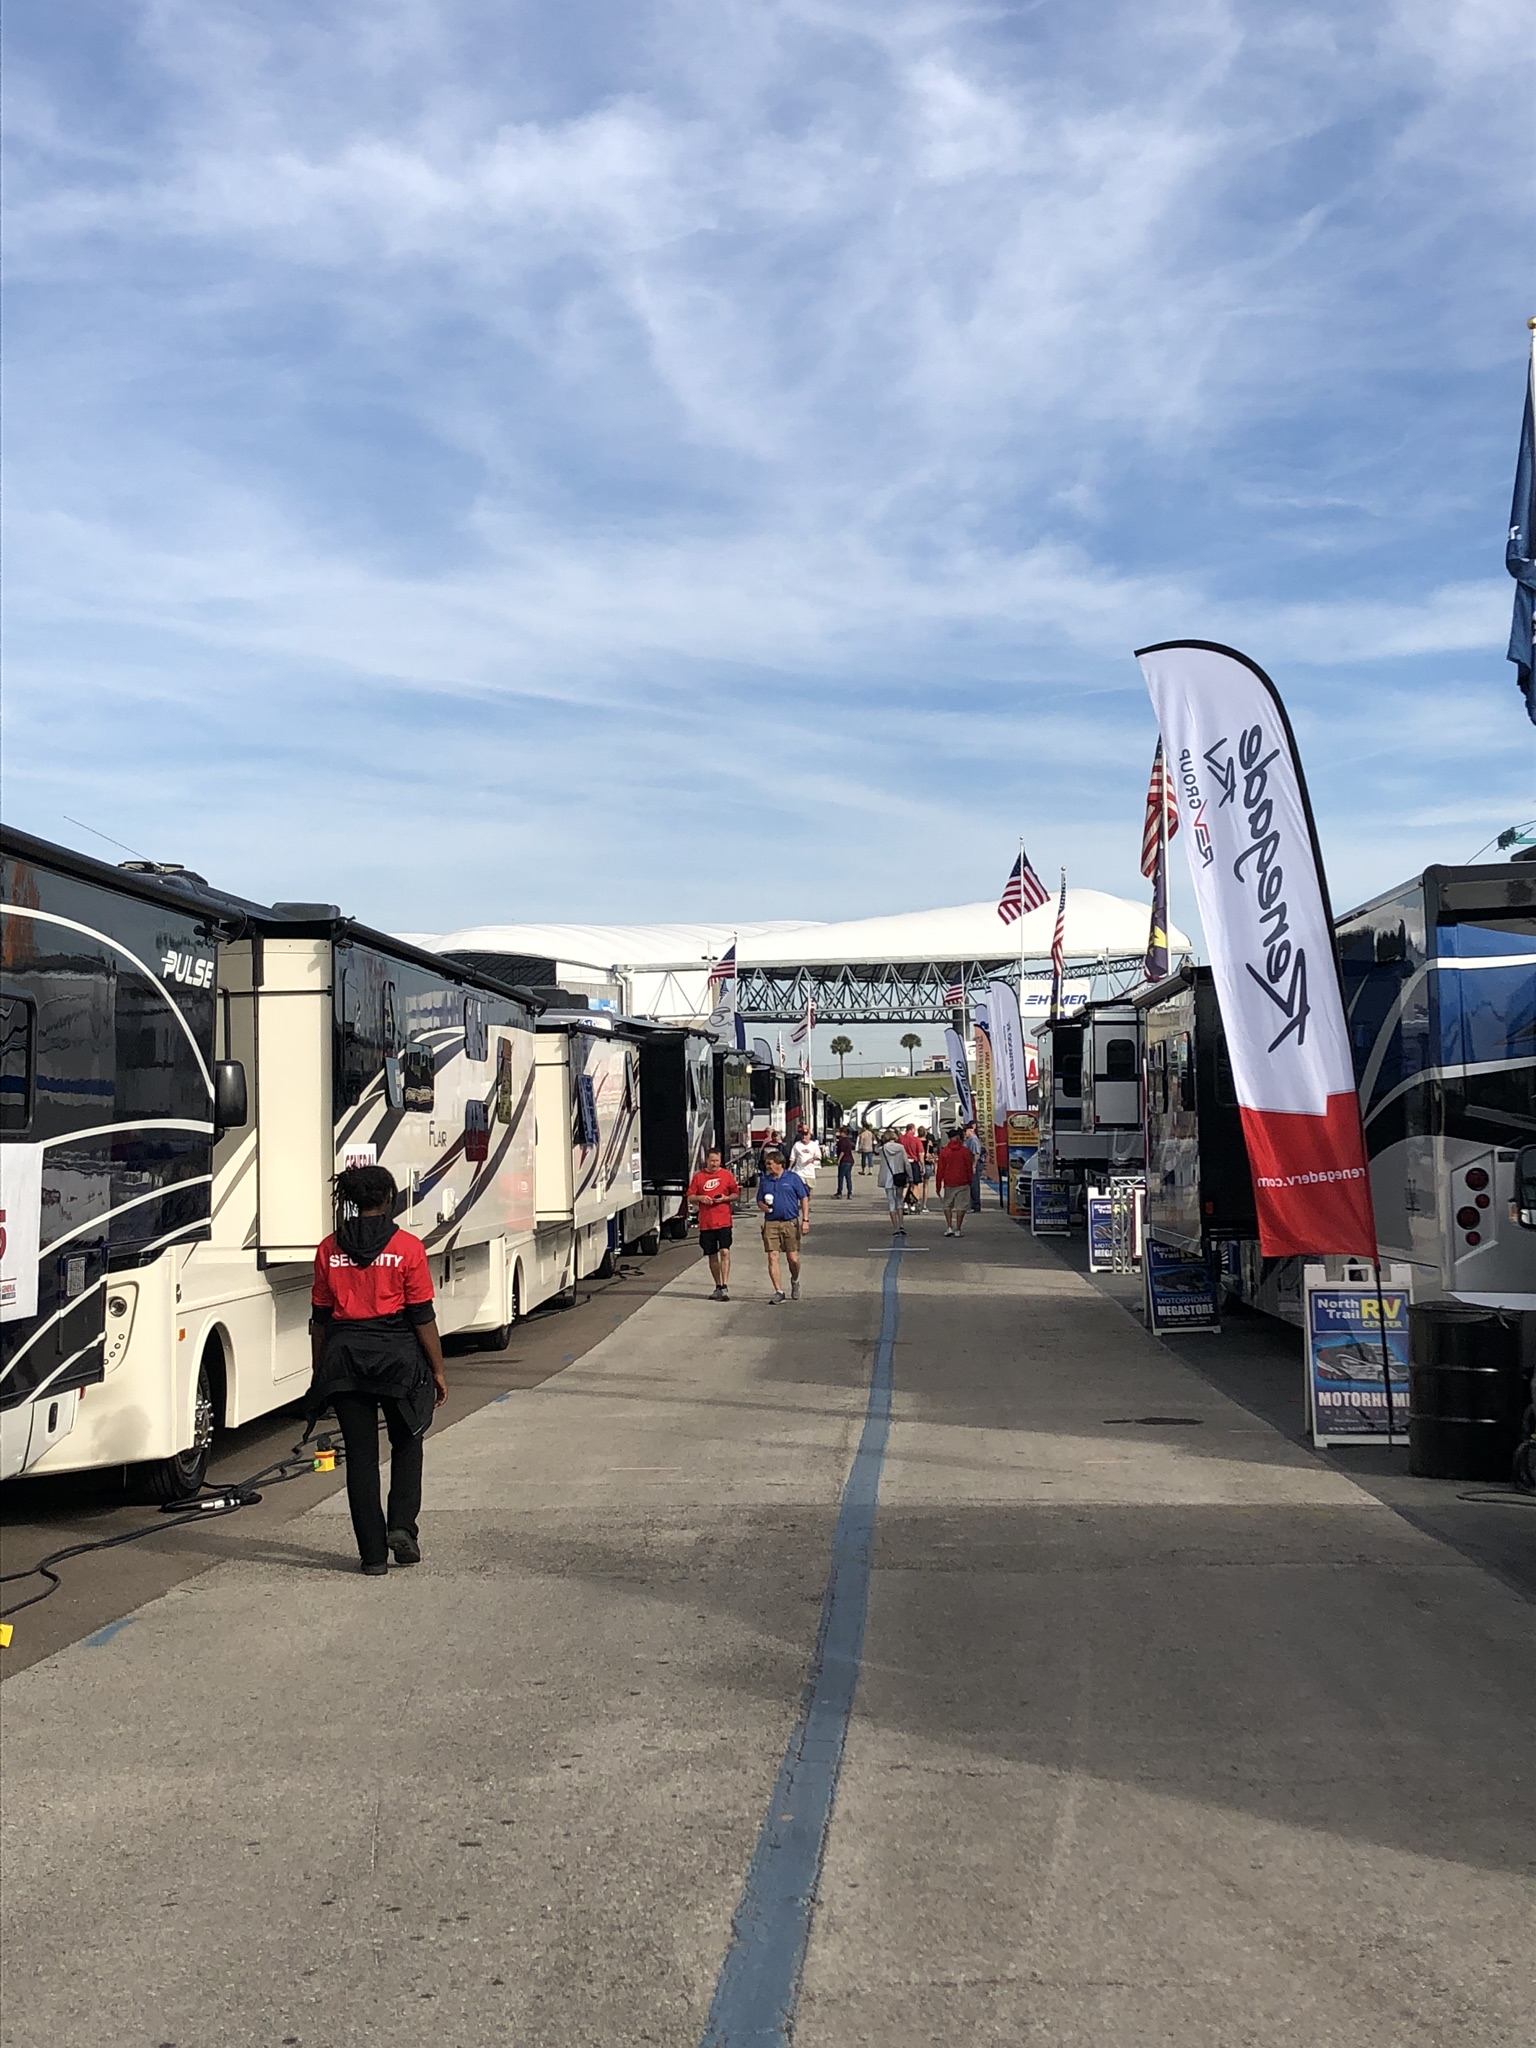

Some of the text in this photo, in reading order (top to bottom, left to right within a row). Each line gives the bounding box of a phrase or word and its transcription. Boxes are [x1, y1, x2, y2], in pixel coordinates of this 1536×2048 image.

[161, 950, 214, 989] PULSE
[1038, 994, 1087, 1005] HMER
[329, 1253, 403, 1267] SECRITY
[1157, 1295, 1214, 1305] MOTORHOME
[1157, 1303, 1215, 1316] MEGASTORE
[1317, 1296, 1401, 1319] North RV
[1325, 1309, 1361, 1319] Trail
